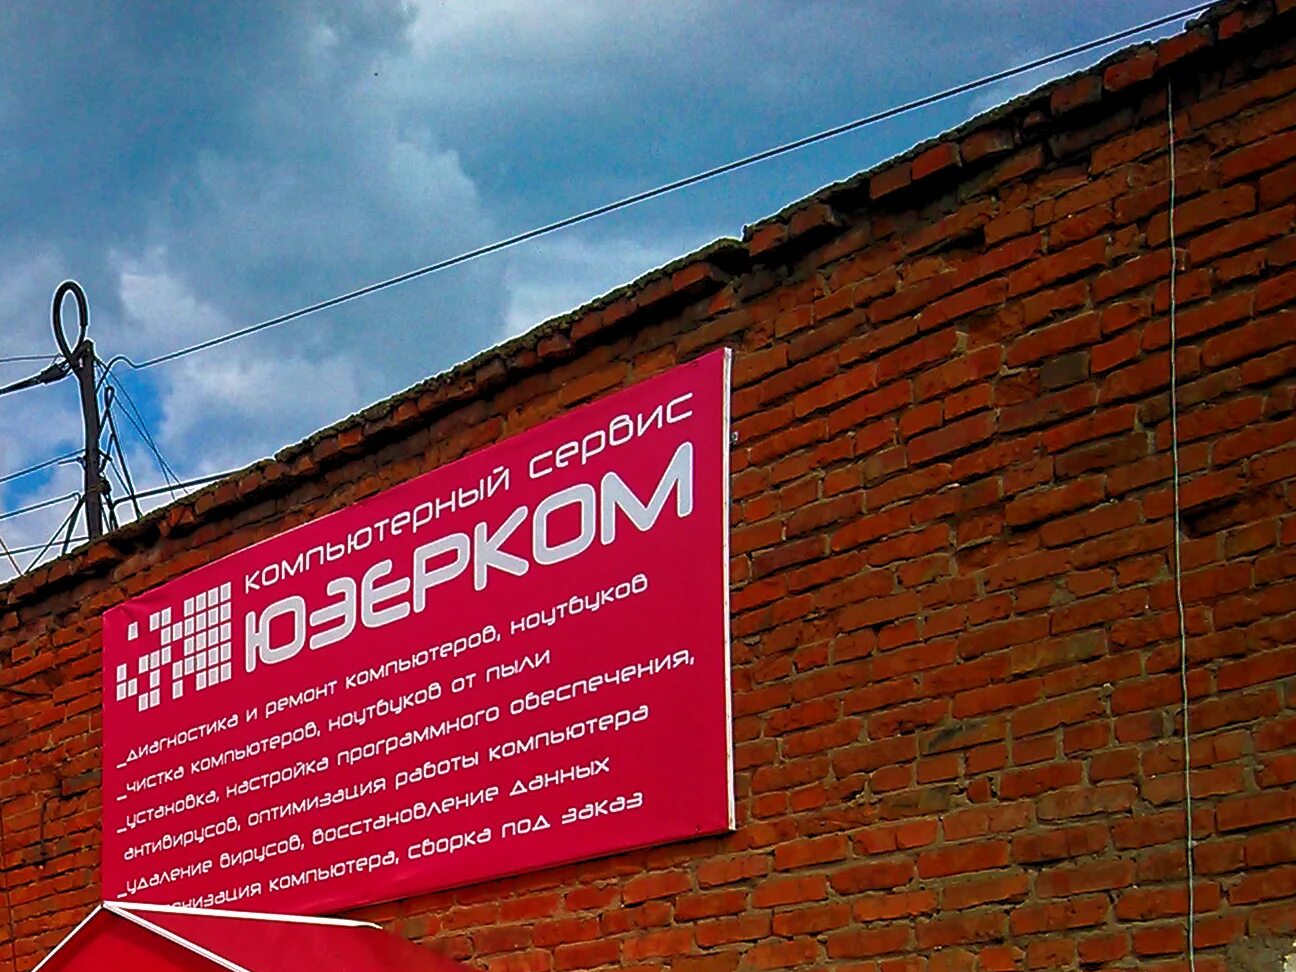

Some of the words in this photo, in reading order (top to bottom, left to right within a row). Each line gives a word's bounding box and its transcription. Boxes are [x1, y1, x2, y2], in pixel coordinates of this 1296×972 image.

[244, 441, 694, 673] ЮЗЕРКОМ
[245, 466, 509, 594] компьютерный
[529, 392, 694, 479] сервис
[190, 721, 321, 775] компьютеров,
[328, 682, 442, 732] ноутбуков
[451, 672, 477, 694] от
[486, 649, 552, 683] пыли
[245, 707, 258, 722] и
[265, 680, 338, 718] ремонт
[345, 625, 501, 690] компьютеров,
[510, 573, 649, 635] ноутбуков
[123, 816, 241, 861] антивирусов,
[247, 777, 386, 827] оптимизация
[394, 751, 479, 790] работы
[488, 704, 649, 762] компьютера
[226, 756, 329, 798] настройка
[337, 705, 500, 765] программного
[510, 649, 695, 715] обеспечения,
[219, 834, 305, 870] вирусов,
[311, 785, 499, 846] восстановление
[509, 757, 610, 797] данных
[269, 850, 400, 892] компьютера,
[407, 827, 492, 860] сборка
[501, 815, 551, 838] под
[561, 792, 644, 825] заказ
